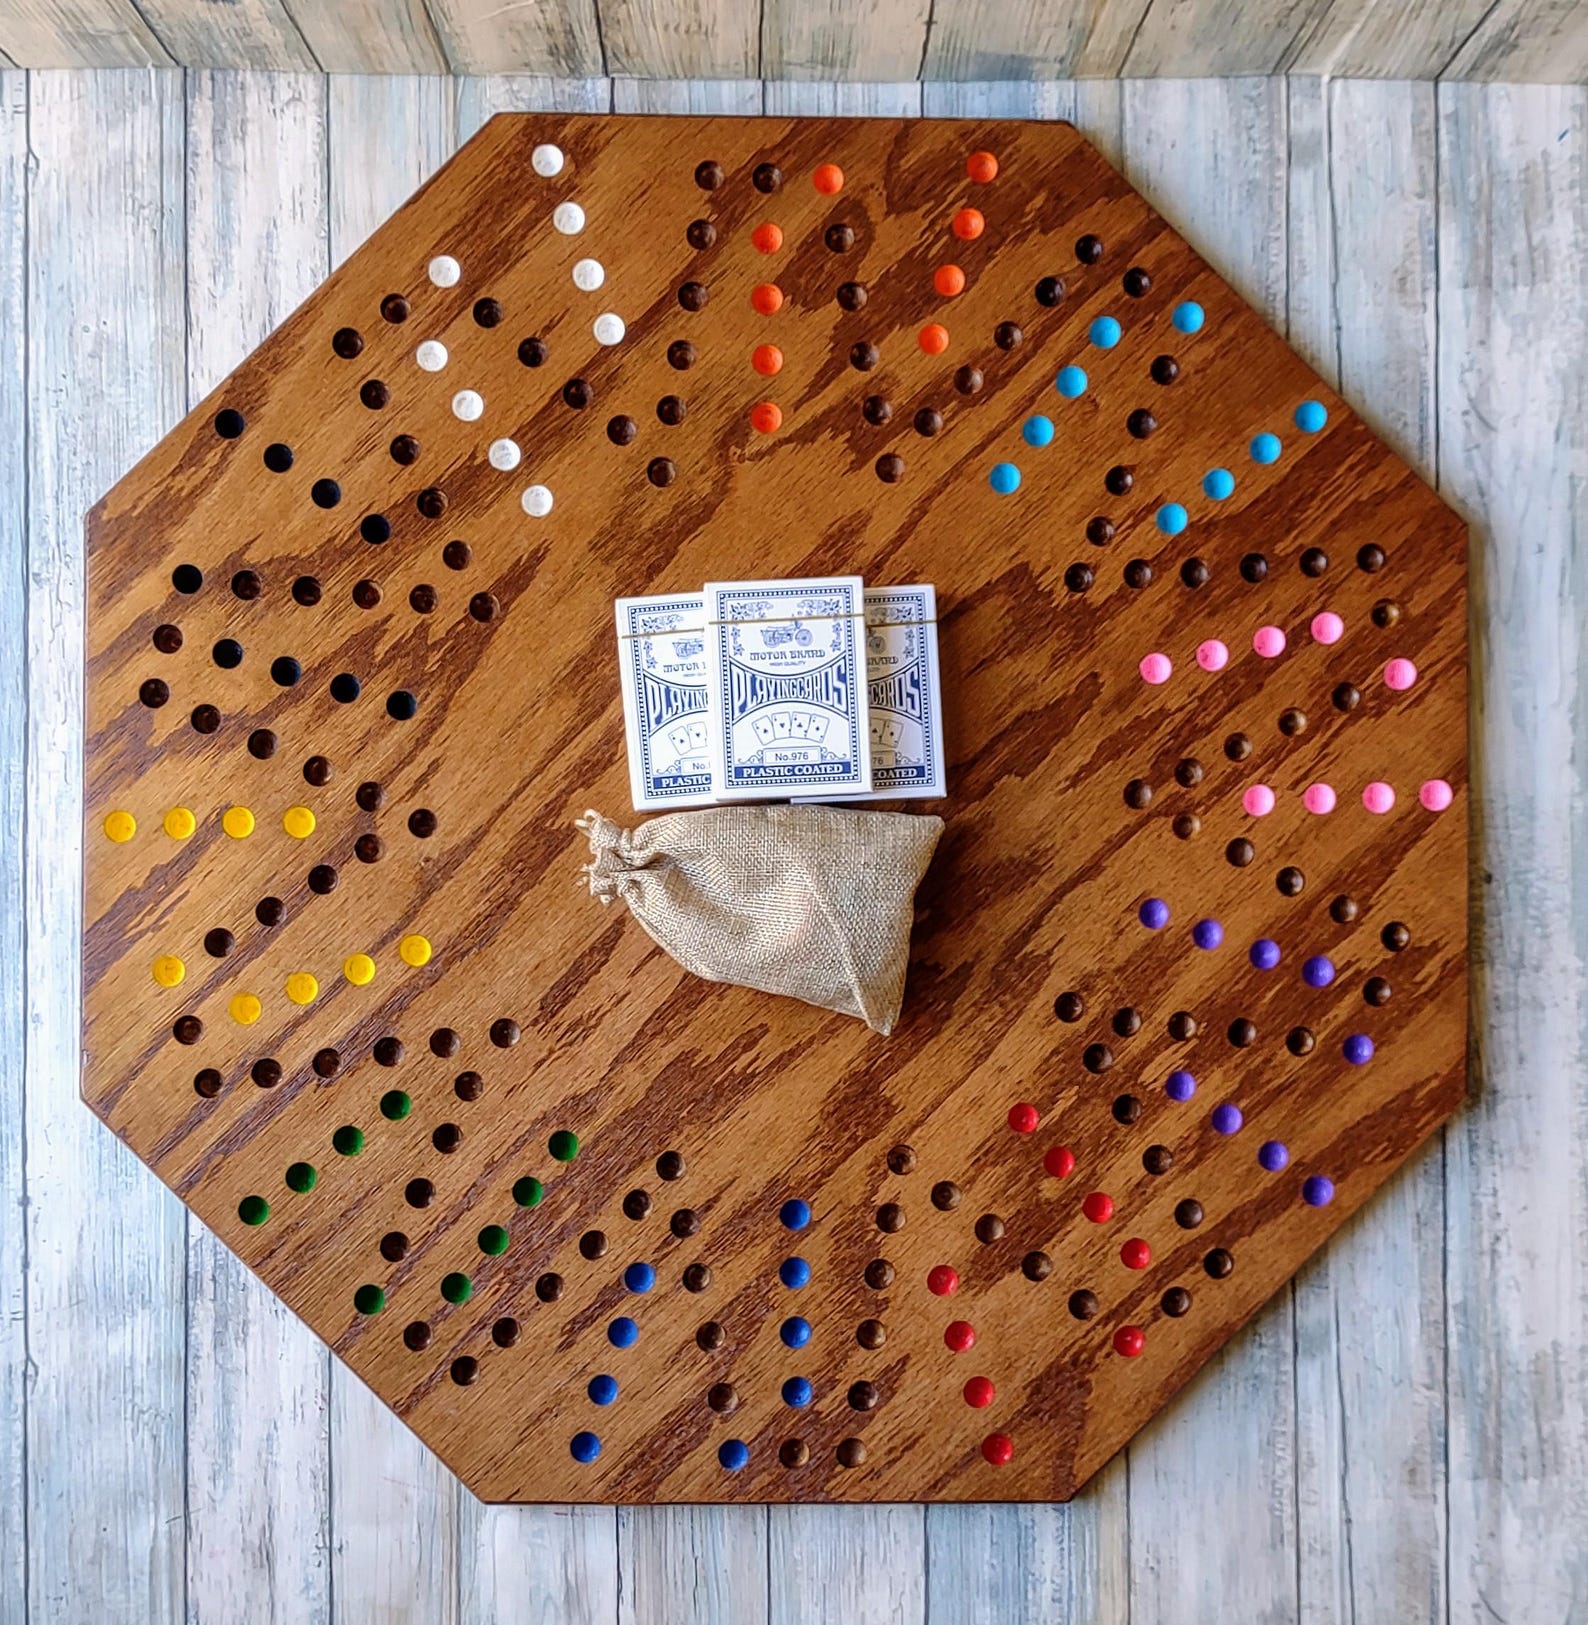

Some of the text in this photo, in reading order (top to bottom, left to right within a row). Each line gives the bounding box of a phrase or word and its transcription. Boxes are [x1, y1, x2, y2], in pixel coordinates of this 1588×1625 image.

[750, 649, 826, 661] MOTOR BRAND
[868, 656, 899, 666] RAND
[868, 662, 922, 720] CARDS
[774, 751, 809, 762] No.976
[692, 762, 710, 770] No.
[742, 763, 844, 778] PLASTIC COATED
[661, 774, 711, 788] PLASTIC
